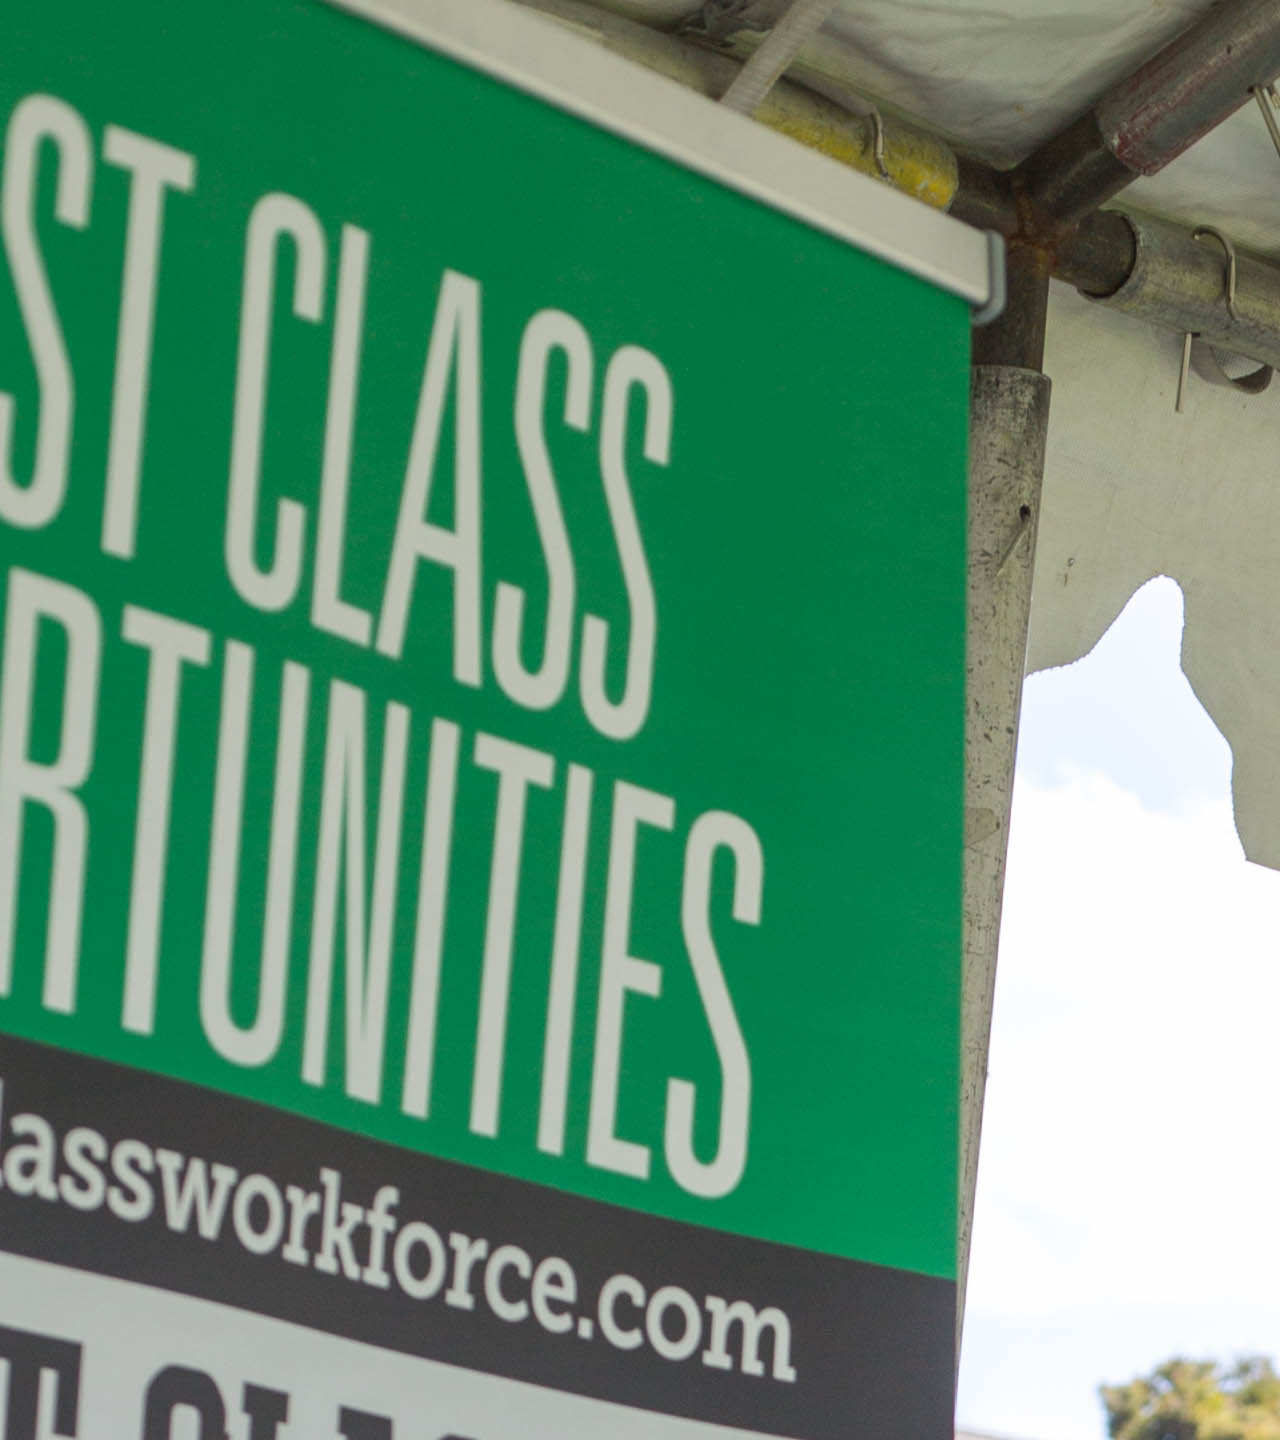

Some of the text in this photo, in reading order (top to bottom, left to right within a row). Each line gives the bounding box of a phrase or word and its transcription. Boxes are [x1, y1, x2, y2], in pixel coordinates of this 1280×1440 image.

[223, 191, 676, 742] CLASS
[0, 565, 765, 1200] RTUNITIES
[0, 1080, 798, 1383] assworkforce.com
